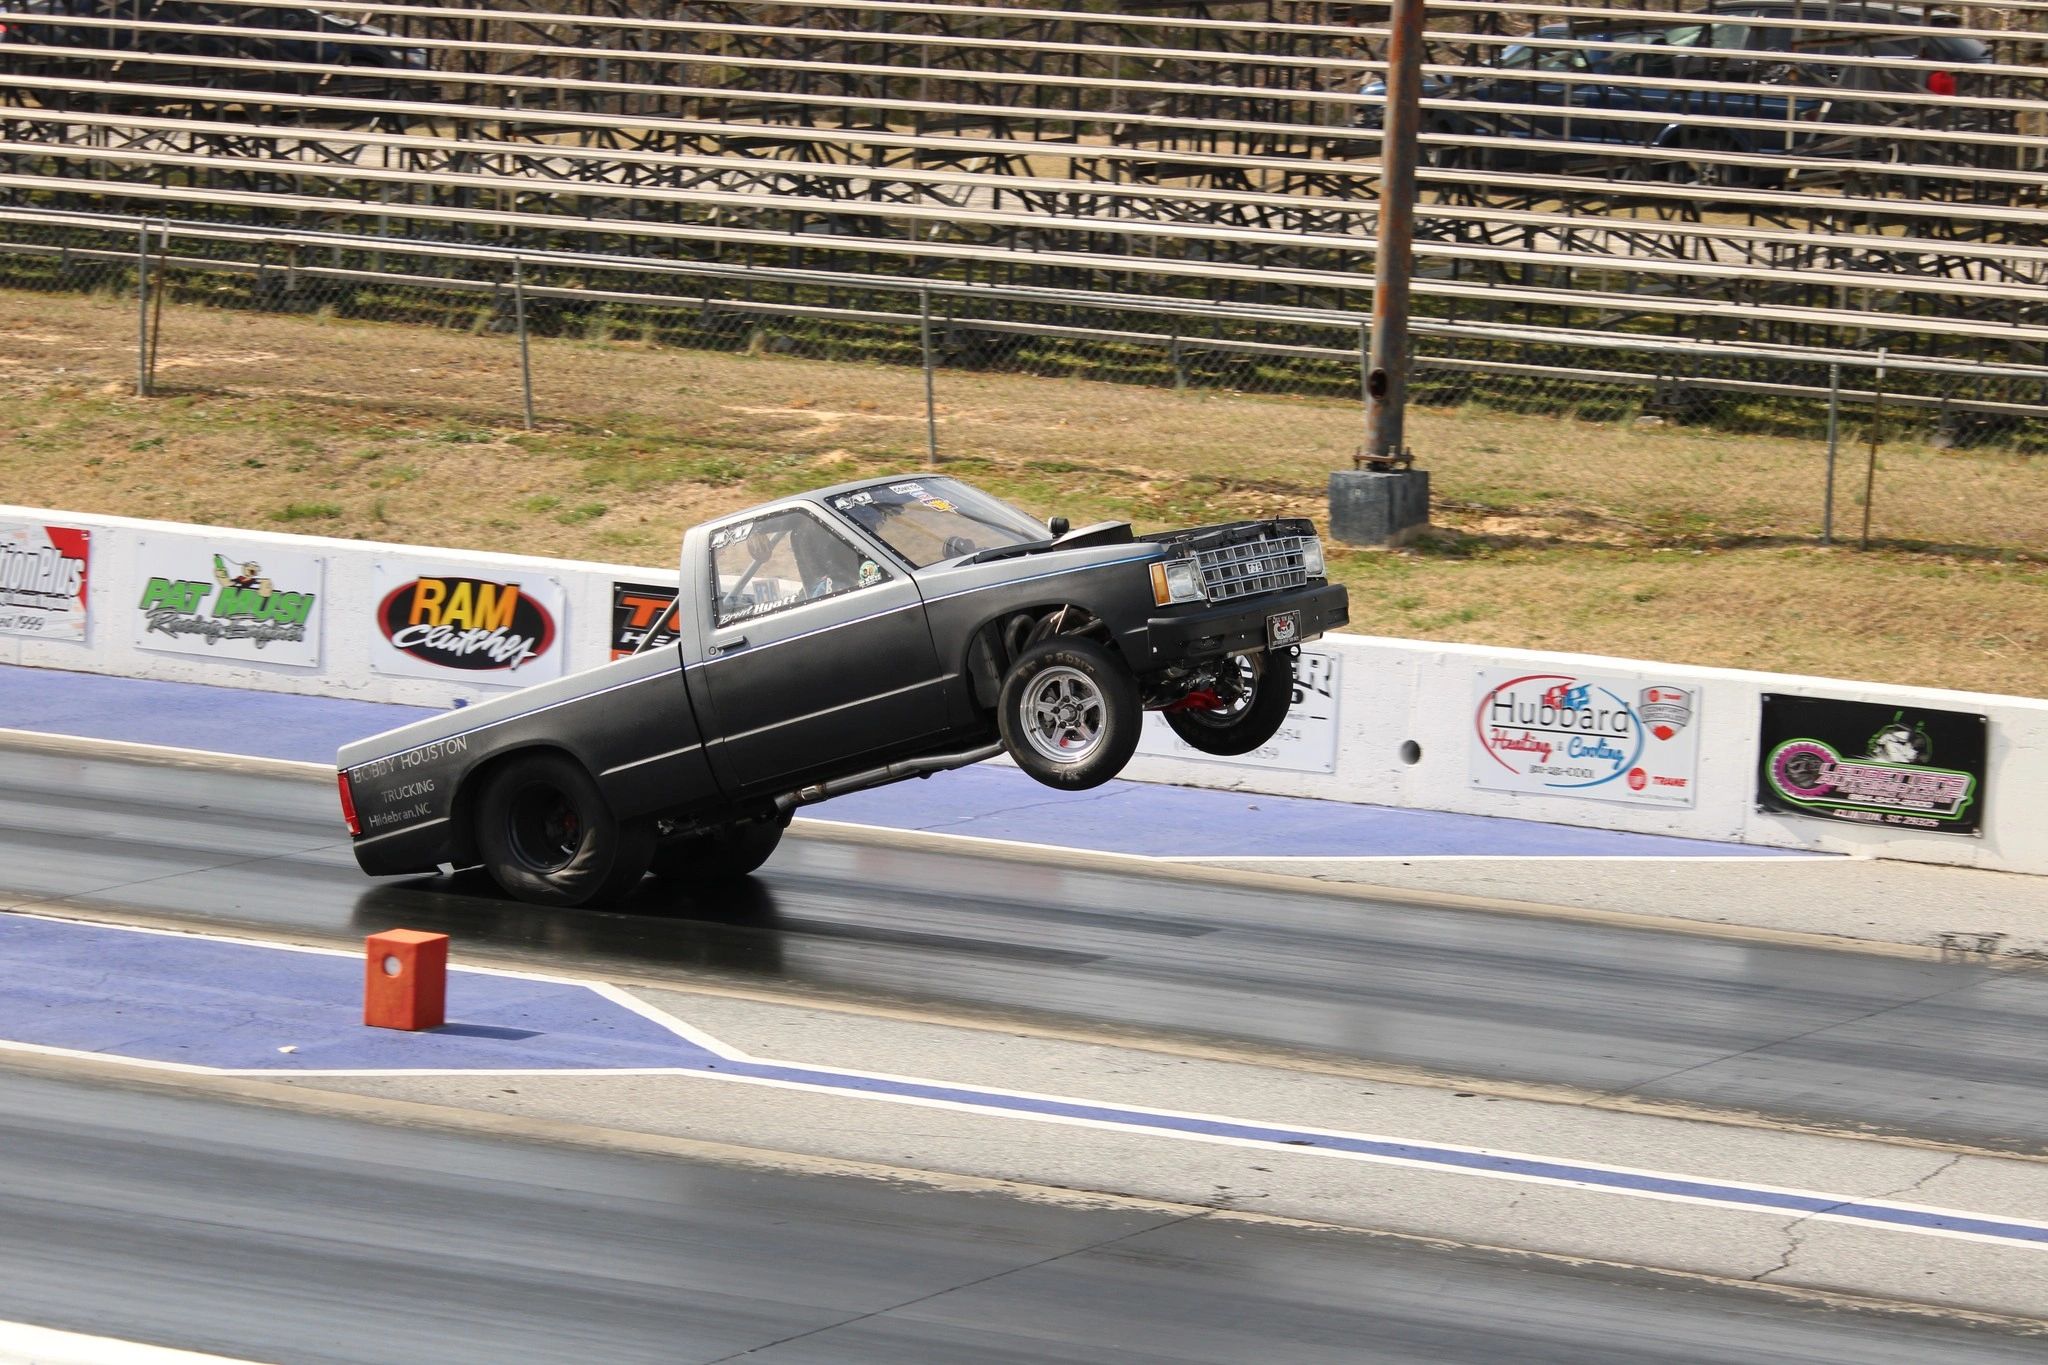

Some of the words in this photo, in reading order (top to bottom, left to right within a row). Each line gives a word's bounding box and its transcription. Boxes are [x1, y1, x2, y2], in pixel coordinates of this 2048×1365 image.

[139, 576, 213, 616] PAT
[212, 585, 315, 626] MUSI
[409, 576, 520, 631] RAM
[719, 605, 753, 625] Brent
[753, 594, 798, 614] Hyatt
[391, 624, 538, 670] Clutches
[1491, 690, 1630, 733] Hubbard
[353, 758, 394, 784] BOBBY
[401, 736, 468, 770] HOUSTON
[1490, 728, 1552, 763] Heating
[1568, 736, 1624, 770] Cooling
[381, 779, 435, 804] TRUCKING
